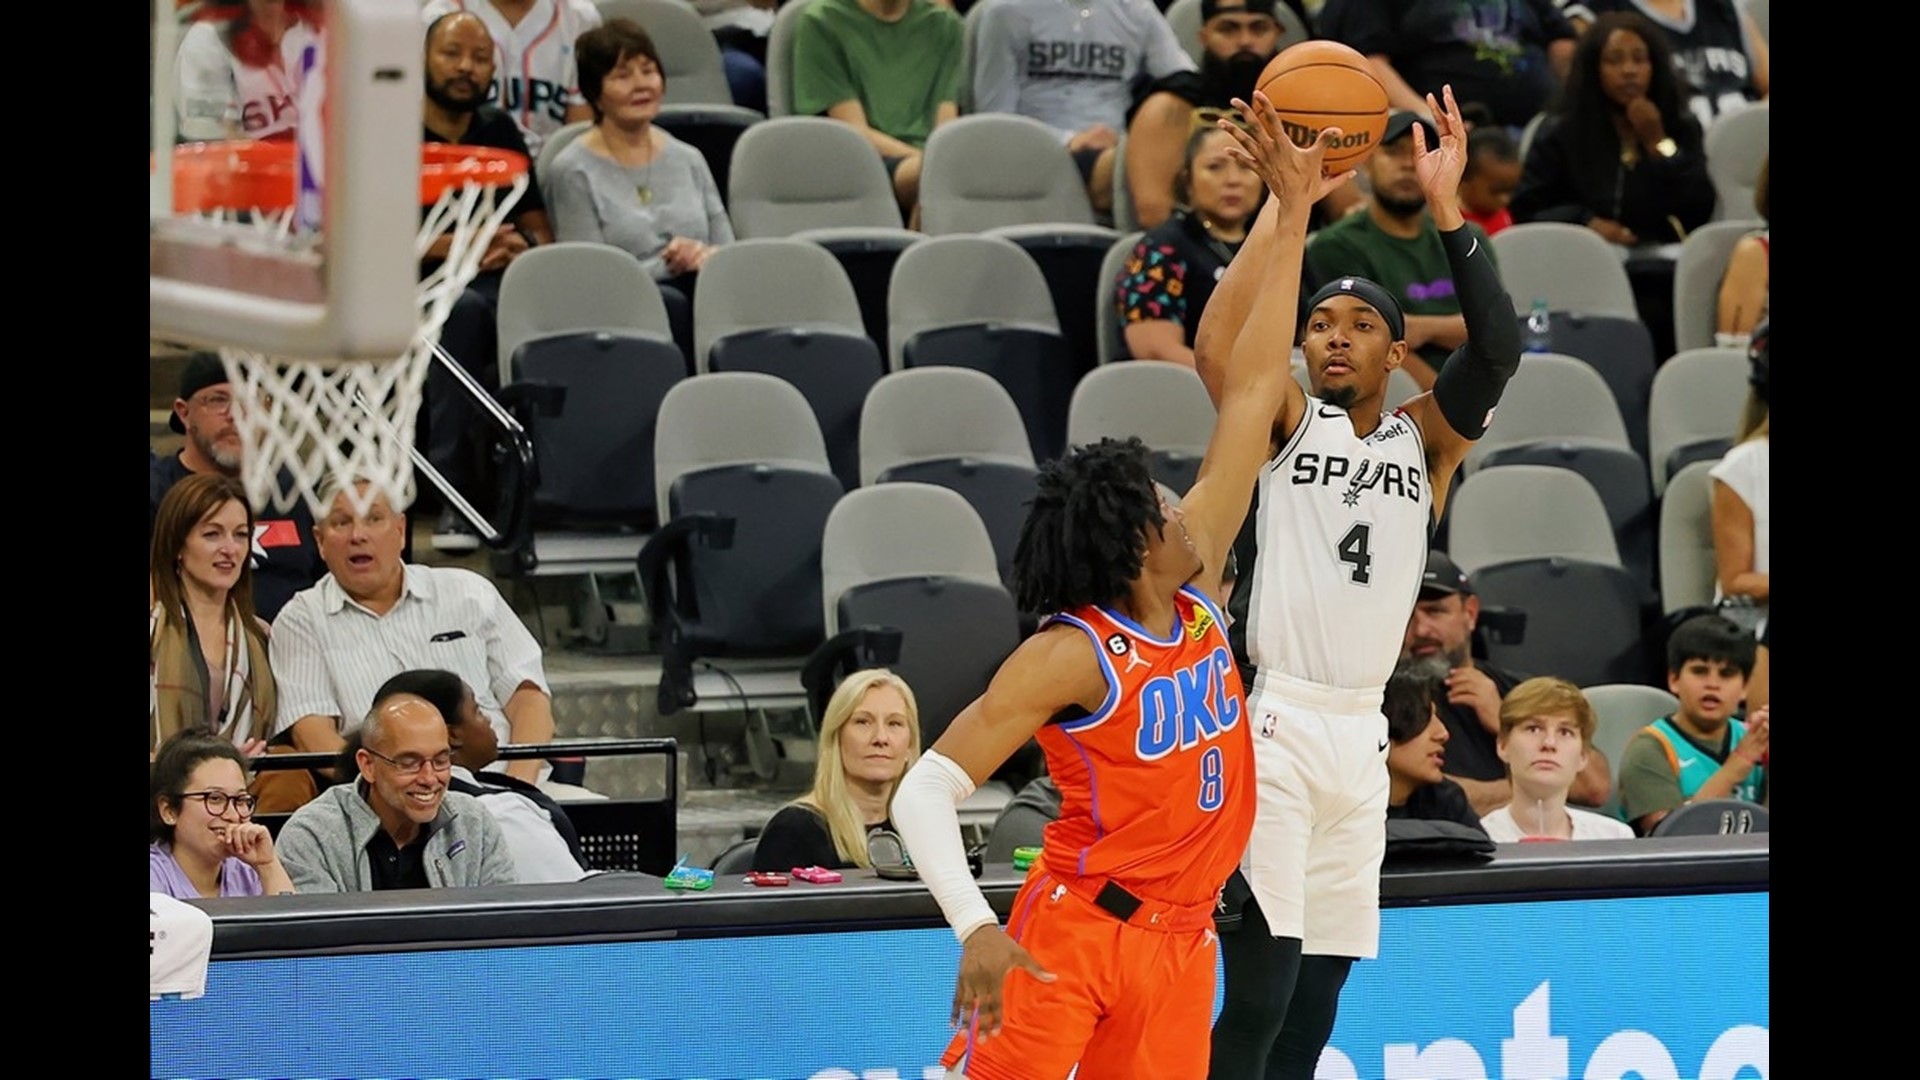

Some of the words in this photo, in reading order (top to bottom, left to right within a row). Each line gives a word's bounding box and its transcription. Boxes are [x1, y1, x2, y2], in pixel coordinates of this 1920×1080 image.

[1028, 42, 1126, 69] SPURS
[1281, 119, 1370, 149] Wison
[1292, 453, 1421, 505] SPURS
[1336, 521, 1373, 587] 4
[1108, 635, 1128, 655] 6
[1136, 647, 1240, 760] OKC
[1198, 746, 1224, 812] 8
